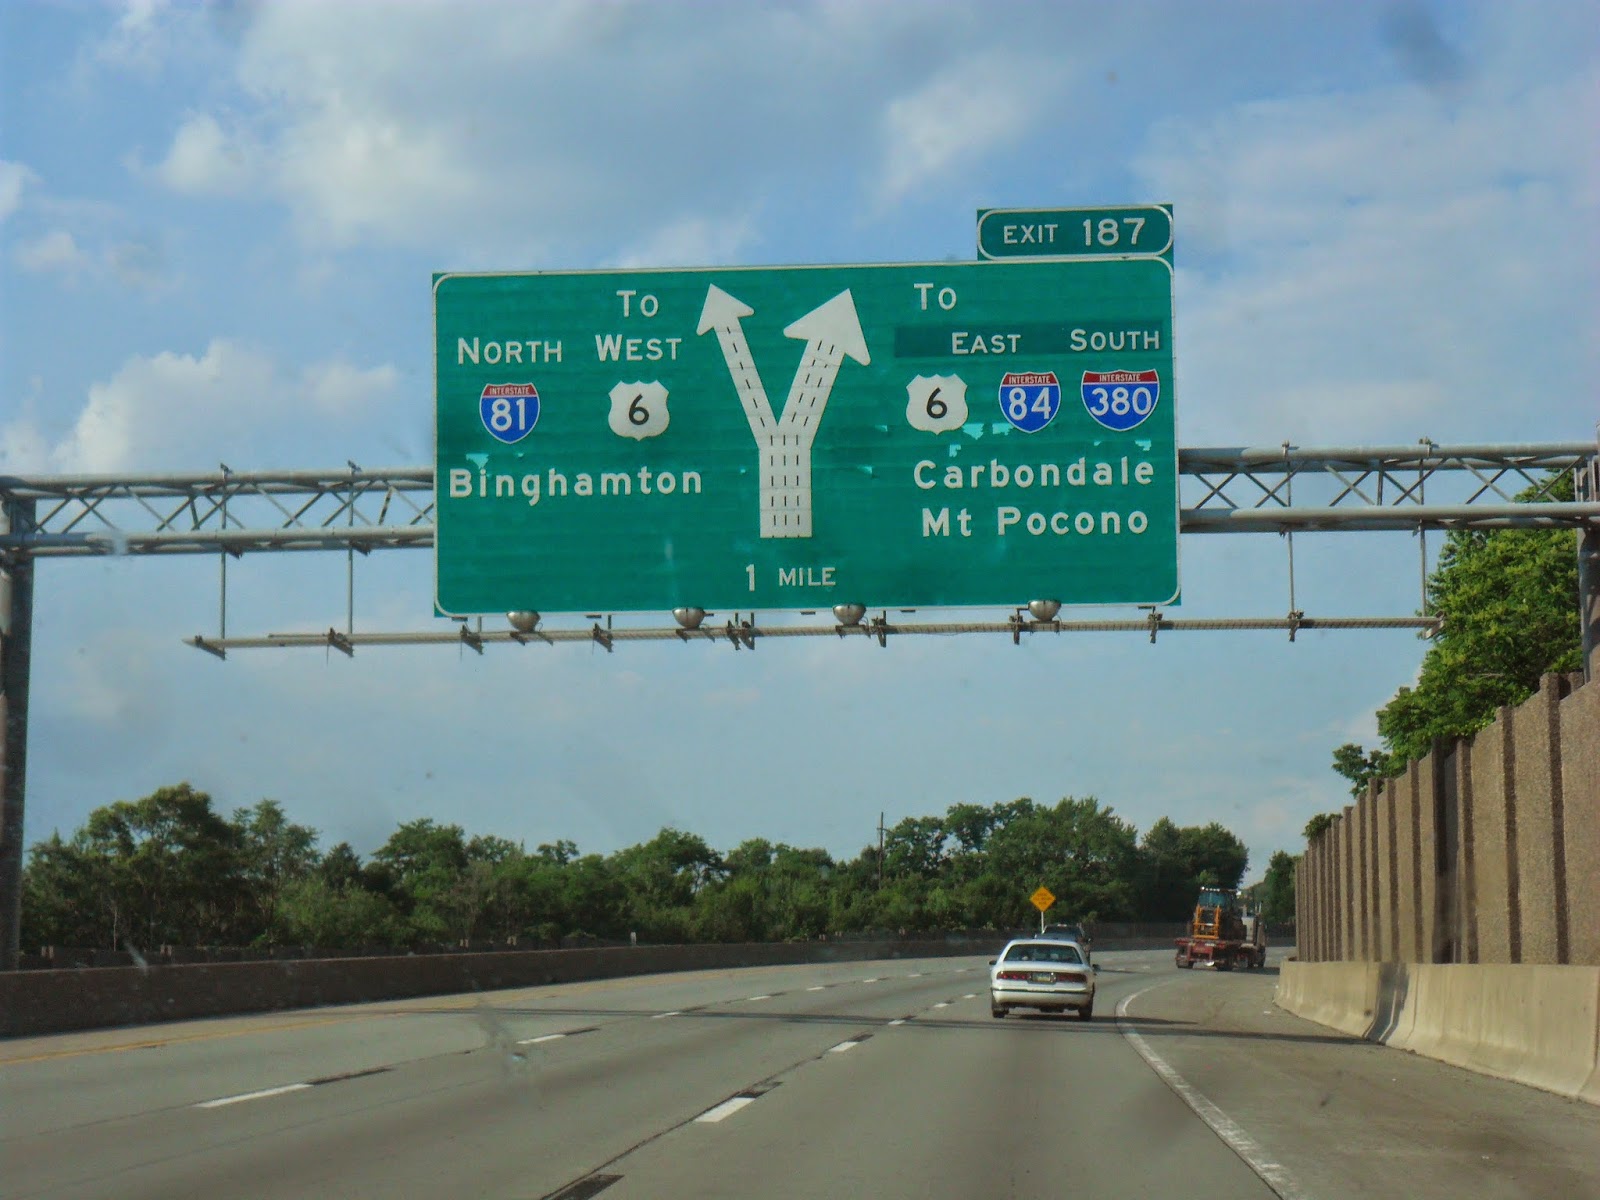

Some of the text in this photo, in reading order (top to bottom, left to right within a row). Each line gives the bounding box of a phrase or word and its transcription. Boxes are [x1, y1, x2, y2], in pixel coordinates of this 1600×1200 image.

[1004, 218, 1145, 246] EXIT 187
[457, 337, 562, 364] NORTH
[596, 334, 682, 362] WEST
[952, 332, 1021, 354] EAST
[1070, 329, 1160, 351] SOUTH
[490, 387, 530, 395] INTERSTATE
[1009, 376, 1050, 384] INTERSTATE
[1100, 374, 1140, 382] INTERSTATE
[490, 398, 526, 432] 81
[628, 393, 649, 425] 6
[925, 387, 948, 419] 6
[1009, 387, 1051, 420] 84
[1090, 387, 1151, 416] 380
[449, 466, 703, 506] Binghamton
[913, 457, 1154, 489] Carbondale
[923, 507, 1149, 537] Mt Pocono
[746, 564, 837, 592] 1 MILE
